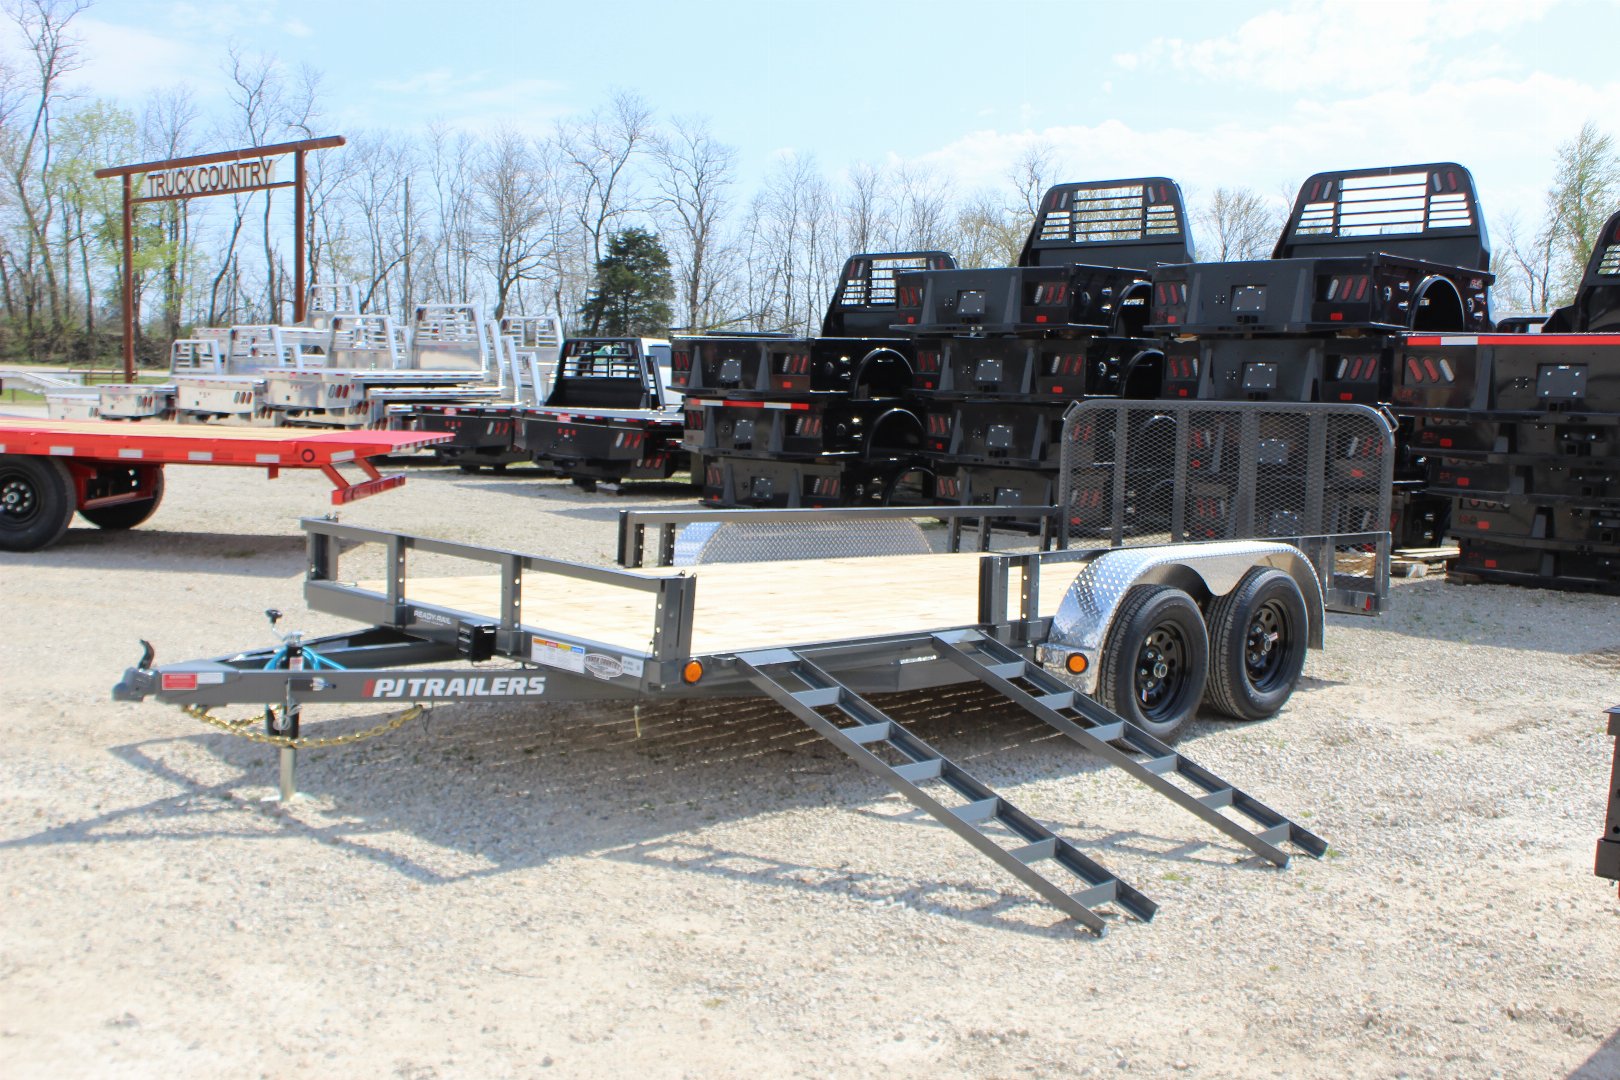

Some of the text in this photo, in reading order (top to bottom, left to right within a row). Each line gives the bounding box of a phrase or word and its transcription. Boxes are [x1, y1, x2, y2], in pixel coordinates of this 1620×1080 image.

[147, 158, 273, 198] TRUCK COUNTRY
[372, 676, 547, 698] PJ TRAILERS
